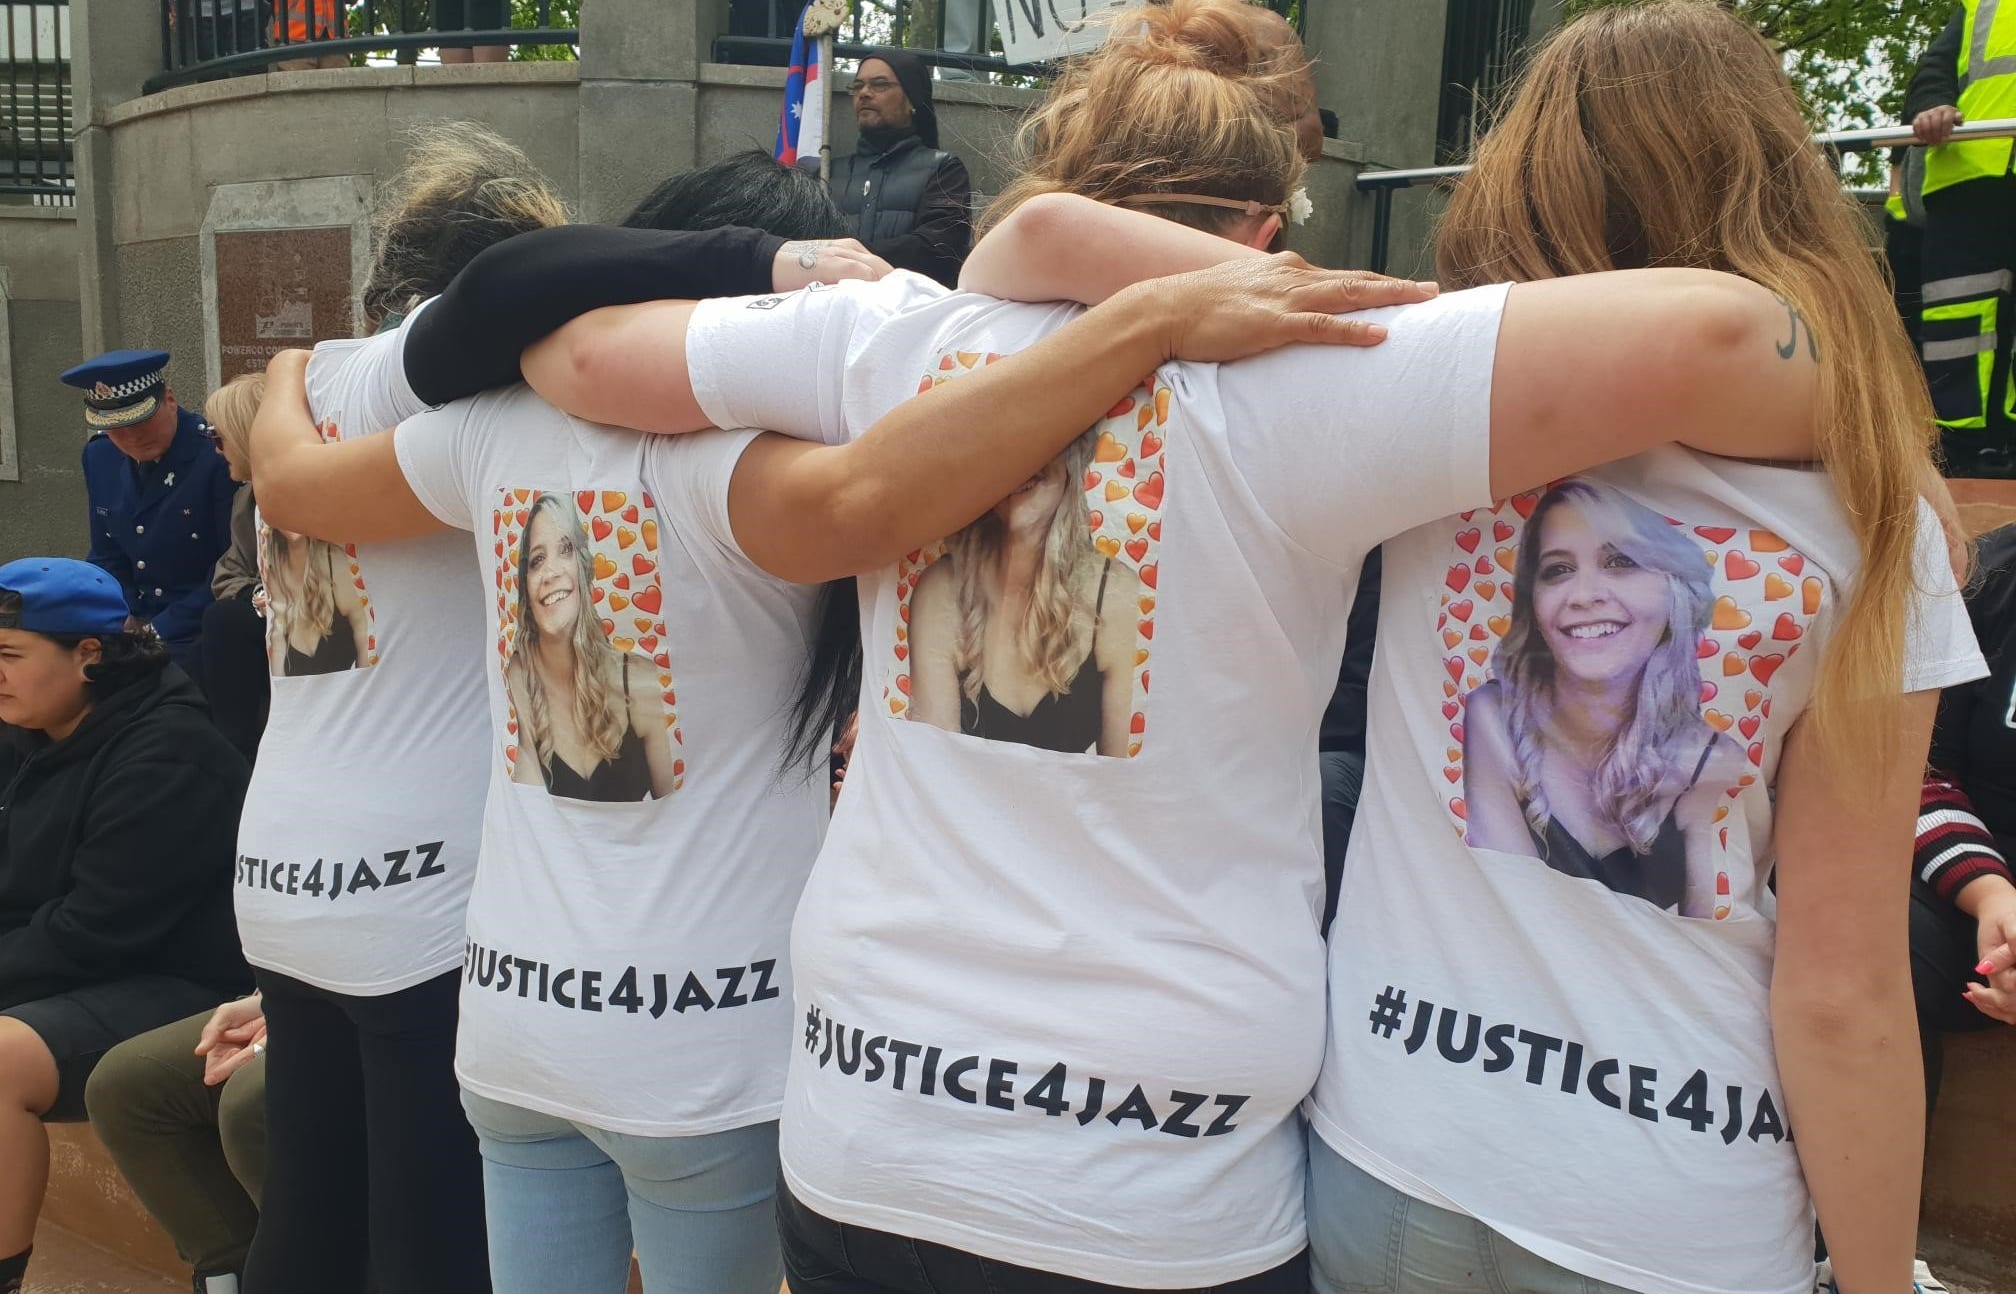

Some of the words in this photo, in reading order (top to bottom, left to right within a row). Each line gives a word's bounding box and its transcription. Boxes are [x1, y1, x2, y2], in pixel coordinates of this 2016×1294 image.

[236, 841, 446, 901] STICE4JAZZ
[464, 935, 780, 1020] #JUSTICE4JAZZ
[805, 1004, 1251, 1138] #JUSTICE4JAZZ
[1369, 985, 1795, 1145] #JUSTICE4JA
